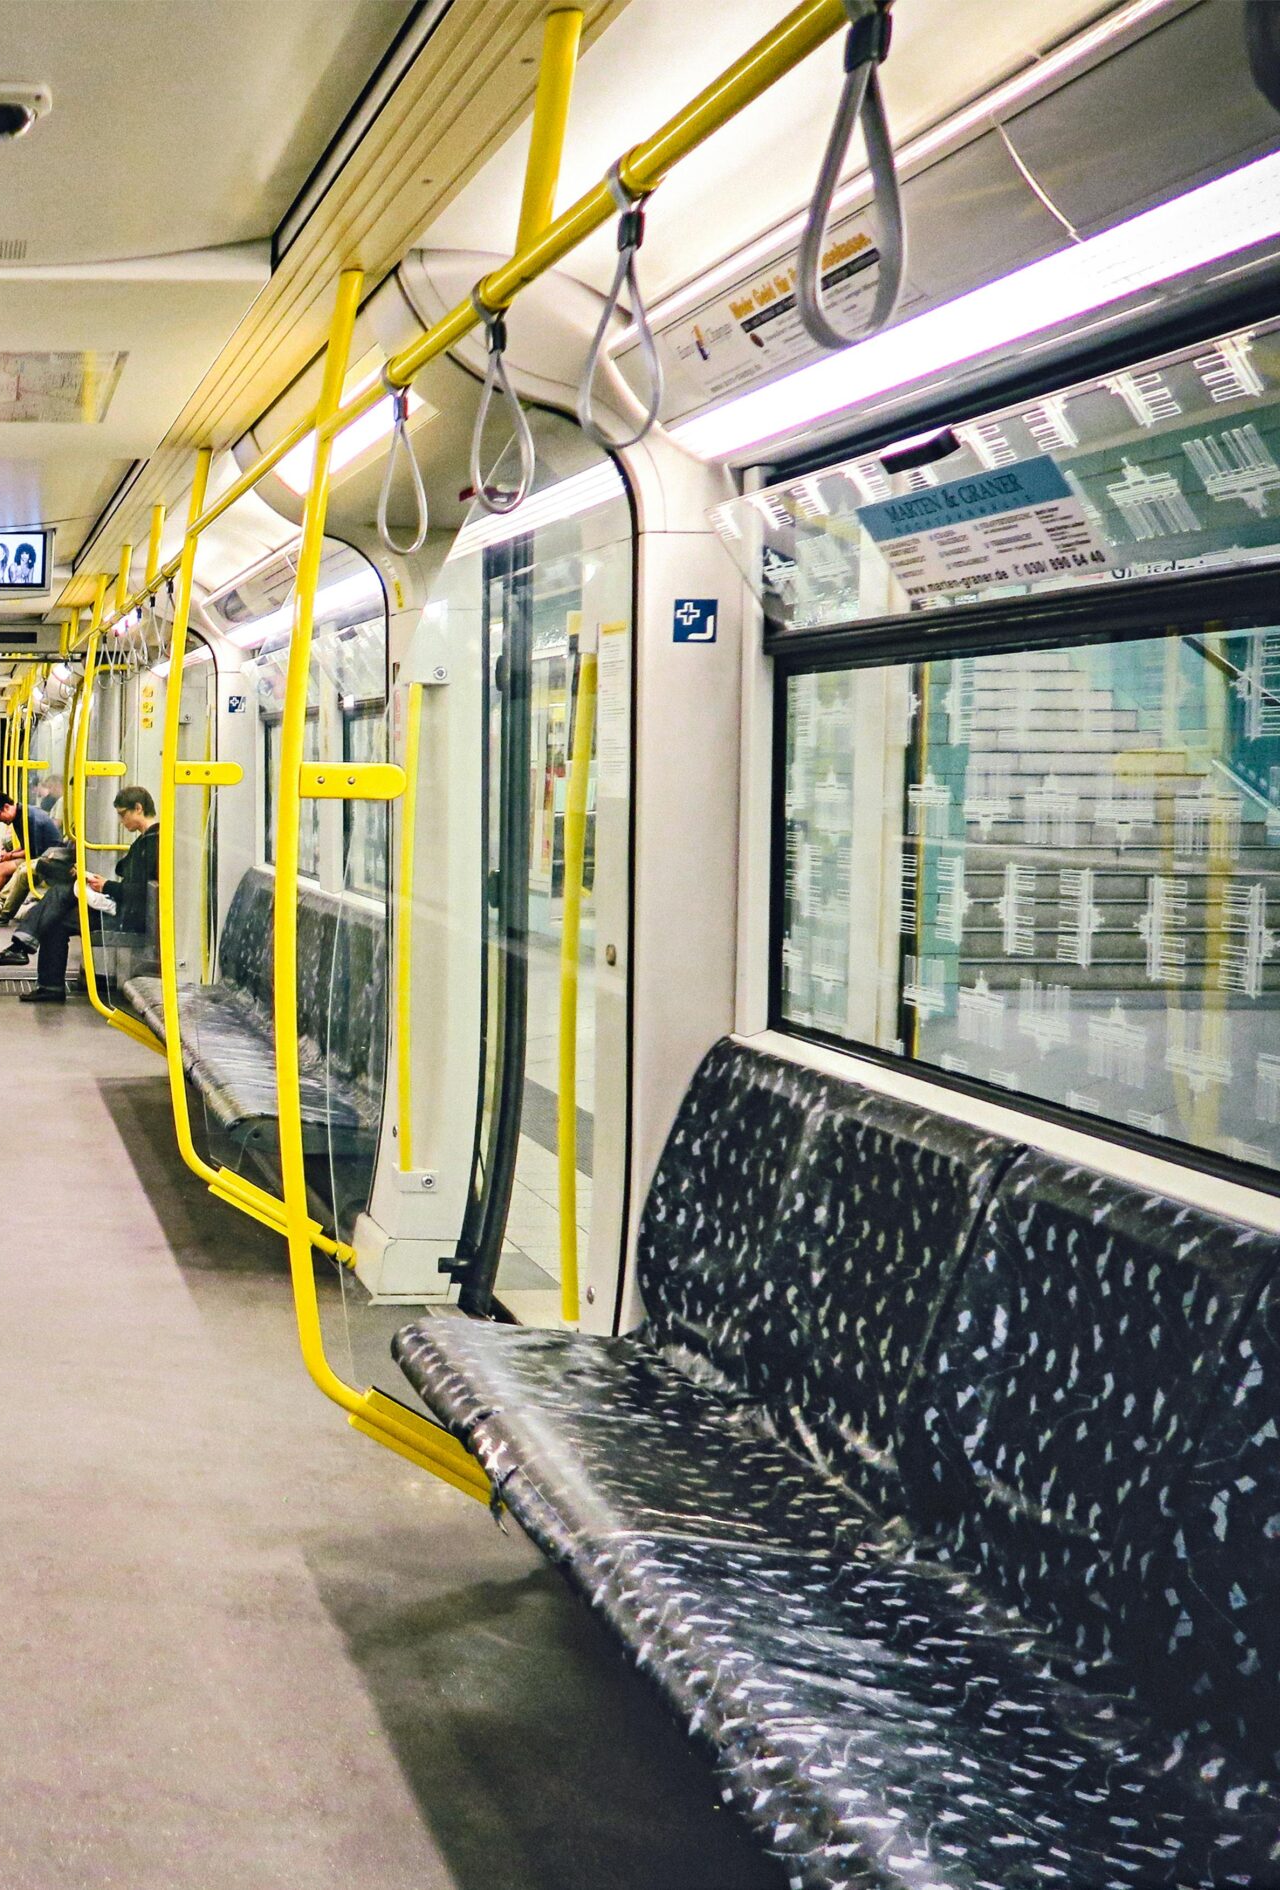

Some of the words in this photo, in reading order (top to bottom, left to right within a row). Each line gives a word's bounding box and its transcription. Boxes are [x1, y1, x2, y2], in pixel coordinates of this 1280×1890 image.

[884, 492, 943, 523] MARTEN
[941, 488, 960, 509] &
[957, 472, 1024, 504] GRANER
[907, 568, 1009, 597] www.marten-graner.de
